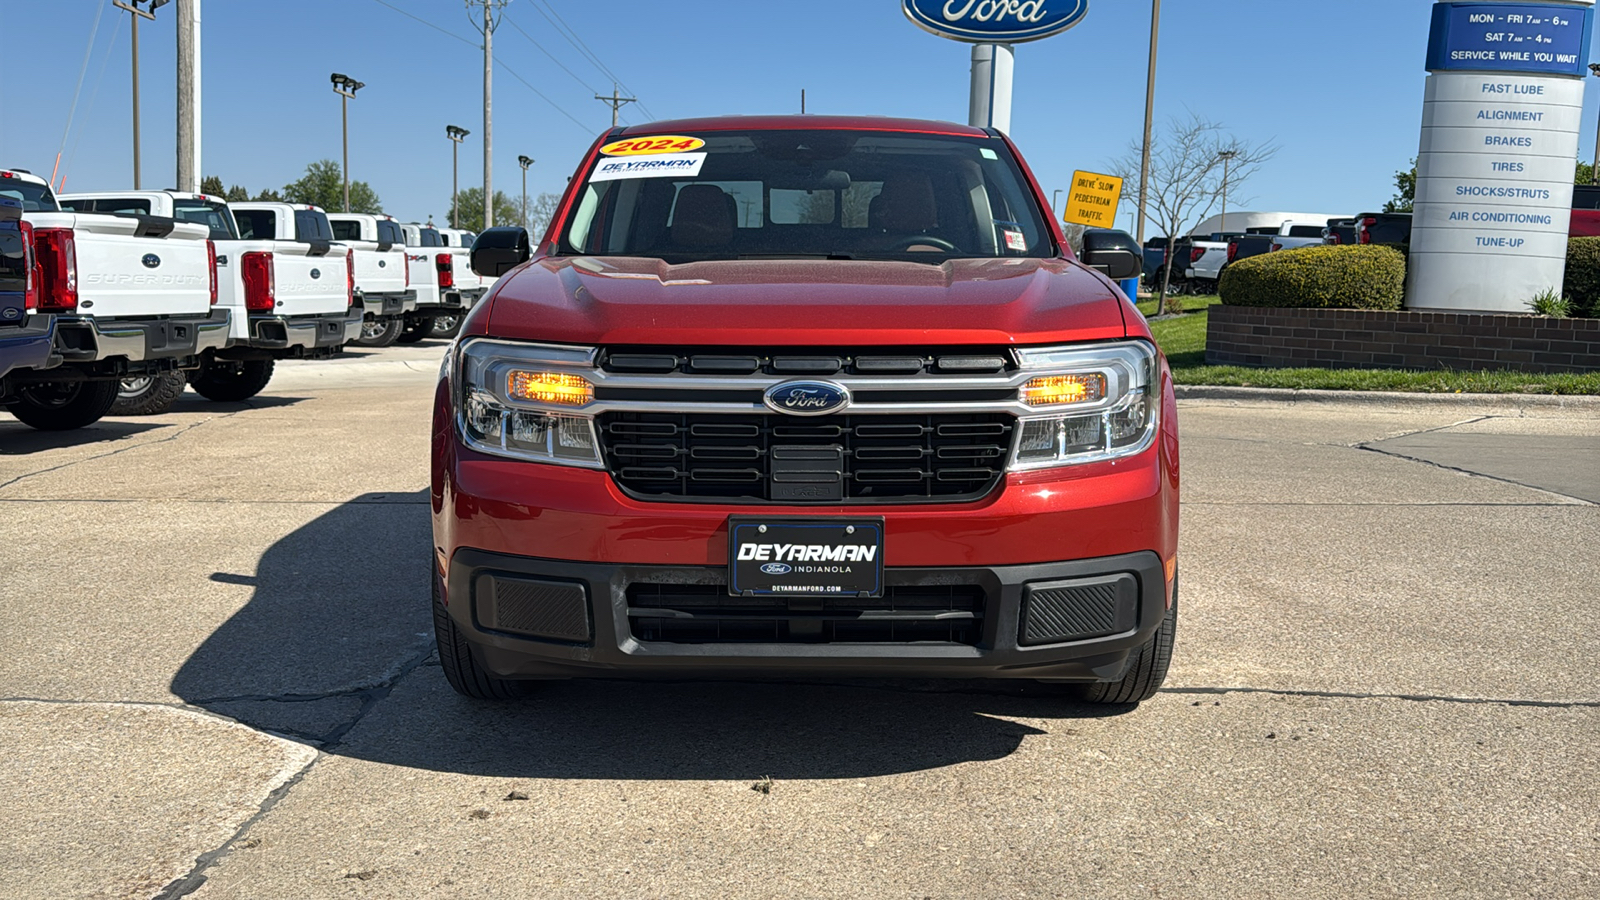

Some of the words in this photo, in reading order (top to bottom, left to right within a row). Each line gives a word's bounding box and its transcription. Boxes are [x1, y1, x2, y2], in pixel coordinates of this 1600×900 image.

[942, 0, 1047, 22] Ford
[1470, 14, 1494, 23] MON
[1507, 15, 1523, 24] FRI
[1485, 33, 1504, 42] SAT
[1451, 51, 1495, 60] SERVICE
[1499, 52, 1530, 61] WHILE
[1534, 53, 1553, 62] YOU
[1556, 54, 1577, 64] WAIT
[1482, 84, 1511, 94] FAST
[1514, 85, 1544, 95] LUBE
[1477, 110, 1544, 122] ALIGNMENT
[608, 139, 695, 153] 2024
[1485, 136, 1532, 147] BRAKES
[601, 159, 698, 171] DEYARMAN
[1492, 162, 1524, 172] TIRES
[1077, 178, 1096, 188] DRIVE
[1098, 181, 1114, 191] SLOW
[1456, 186, 1550, 199] SHOCKS/STRUTS
[1074, 193, 1111, 206] PEDESTRIAN
[1078, 209, 1103, 220] TRAFFIC
[1449, 212, 1469, 222] AIR
[1472, 212, 1551, 225] CONDITIONING
[1475, 237, 1524, 247] TUNE-UP
[87, 274, 158, 285] SUPER
[162, 275, 205, 285] DUTY
[786, 388, 828, 407] Ford
[737, 543, 876, 562] DEYARMAN
[766, 564, 785, 572] Ford
